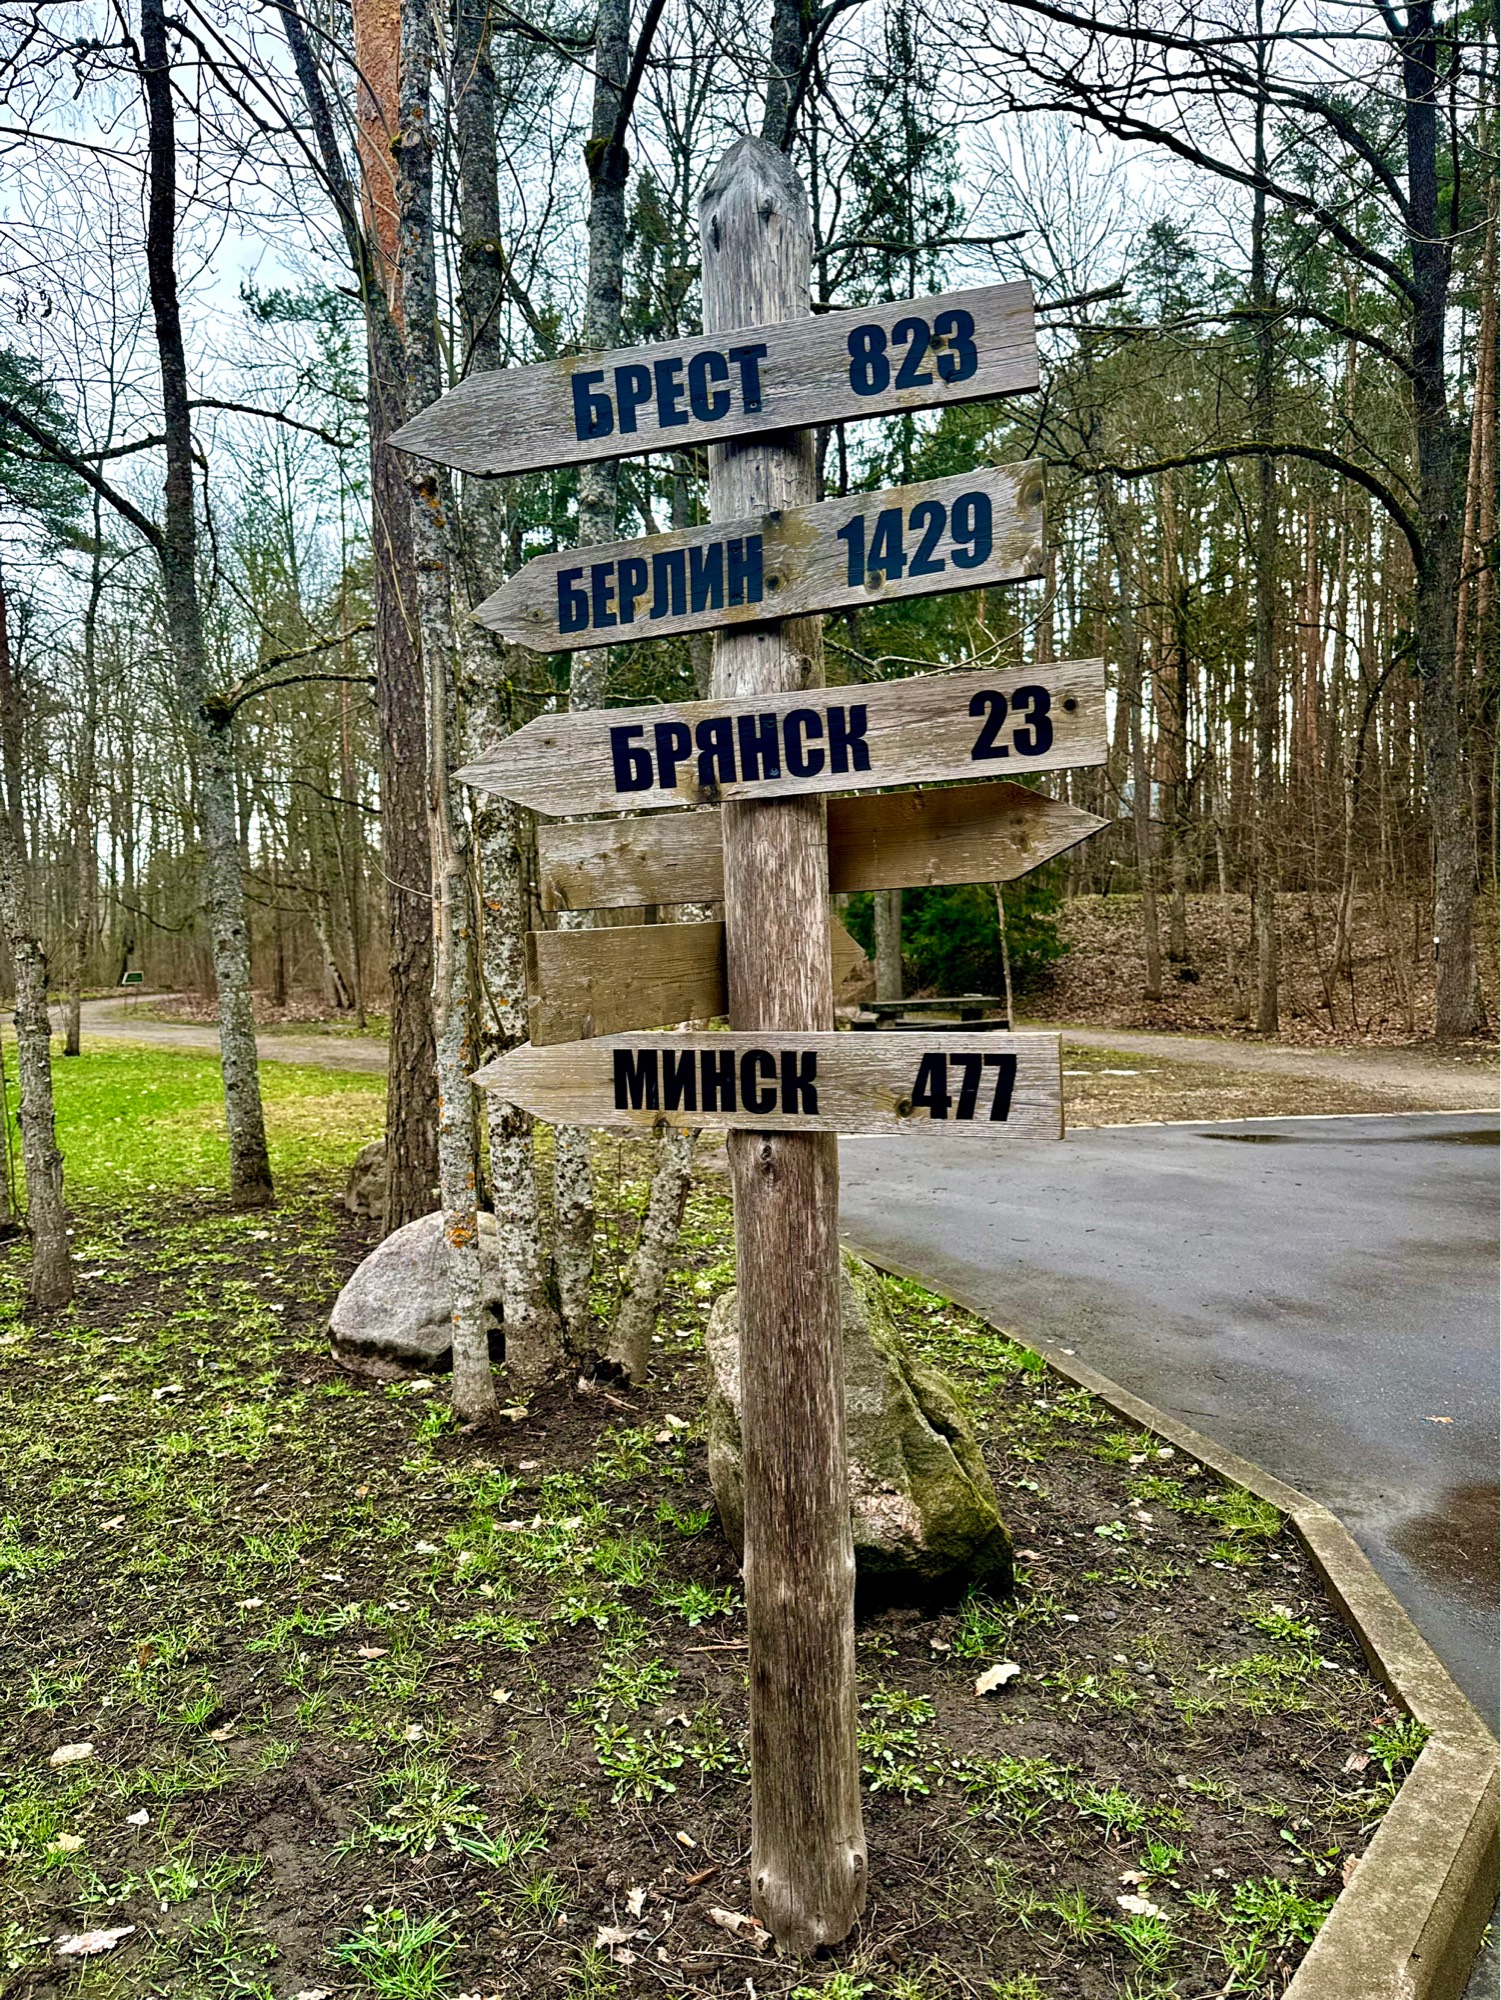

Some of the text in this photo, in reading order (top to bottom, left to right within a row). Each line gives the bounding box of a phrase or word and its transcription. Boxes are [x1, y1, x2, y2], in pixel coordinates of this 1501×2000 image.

[572, 310, 979, 441] БРЕСТ 823
[557, 492, 993, 634] БЕРЛИН 1429
[610, 685, 1053, 793] БРЯНСК 23
[613, 1049, 1018, 1121] МИНСК 477
